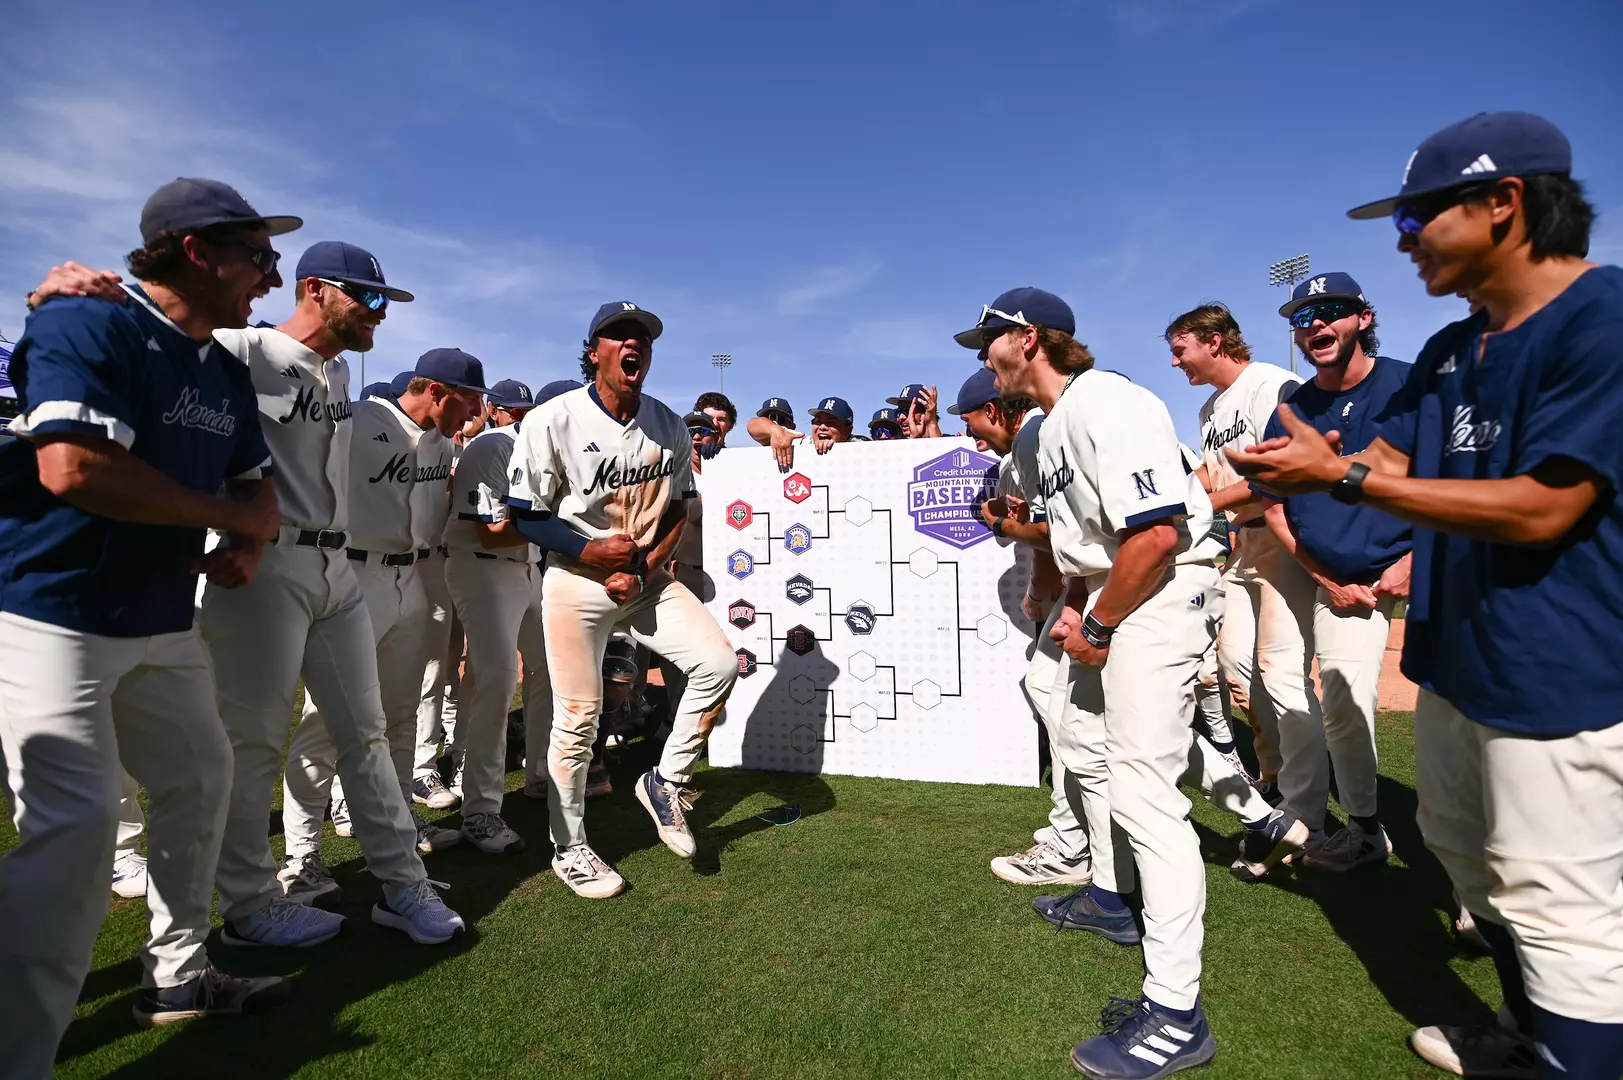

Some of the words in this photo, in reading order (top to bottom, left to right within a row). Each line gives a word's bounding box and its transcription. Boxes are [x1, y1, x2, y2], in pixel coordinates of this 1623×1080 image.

[1308, 277, 1327, 296] N
[518, 386, 528, 399] N
[901, 387, 910, 398] N
[163, 383, 235, 436] Nevada
[279, 384, 352, 423] Nevad
[769, 399, 778, 408] N
[824, 399, 836, 411] N
[880, 410, 889, 419] N
[1204, 409, 1247, 451] Nevada
[583, 445, 674, 496] Nevada
[934, 469, 958, 477] Credit
[960, 468, 984, 476] Union
[926, 478, 970, 488] MOUNTAIN
[973, 478, 998, 486] WEST
[1131, 468, 1161, 500] N
[949, 525, 967, 533] MESA,
[787, 582, 812, 591] NEVADA
[730, 606, 755, 622] UNLV
[849, 610, 874, 627] NEVADA
